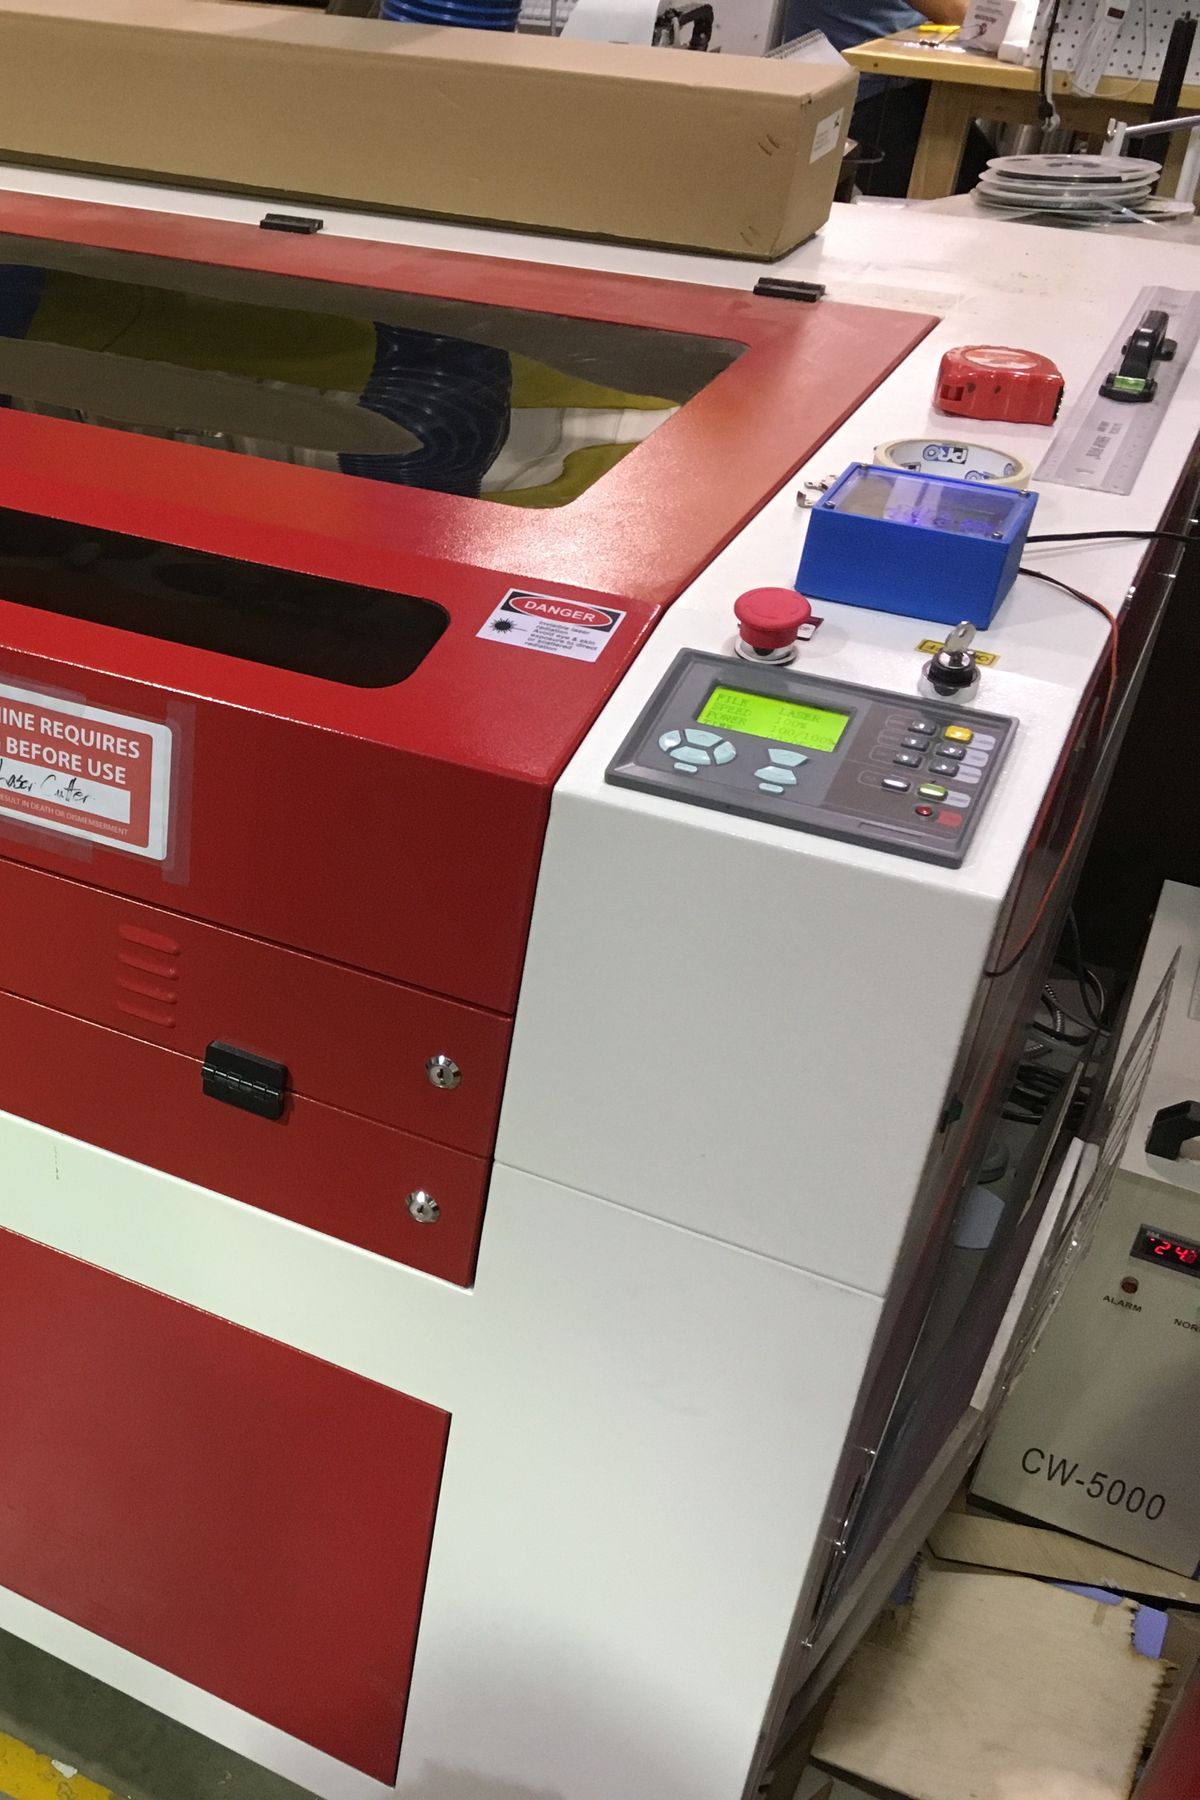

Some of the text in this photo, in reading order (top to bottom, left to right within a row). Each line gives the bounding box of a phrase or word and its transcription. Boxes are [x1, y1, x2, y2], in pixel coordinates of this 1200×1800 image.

[524, 600, 596, 623] DANGER
[706, 711, 748, 726] POWER
[711, 702, 752, 717] SPEED
[779, 707, 822, 723] LASER
[40, 717, 140, 759] REQUIRES
[6, 736, 82, 773] BEFORE
[87, 758, 127, 785] USE
[22, 800, 30, 808] IN
[31, 802, 54, 815] DEATH
[54, 809, 66, 818] OR
[66, 812, 129, 836] DISMEMBERMENT
[1103, 1295, 1142, 1312] ALARM
[1174, 1318, 1200, 1332] NOR
[1021, 1448, 1166, 1520] CW-5000
